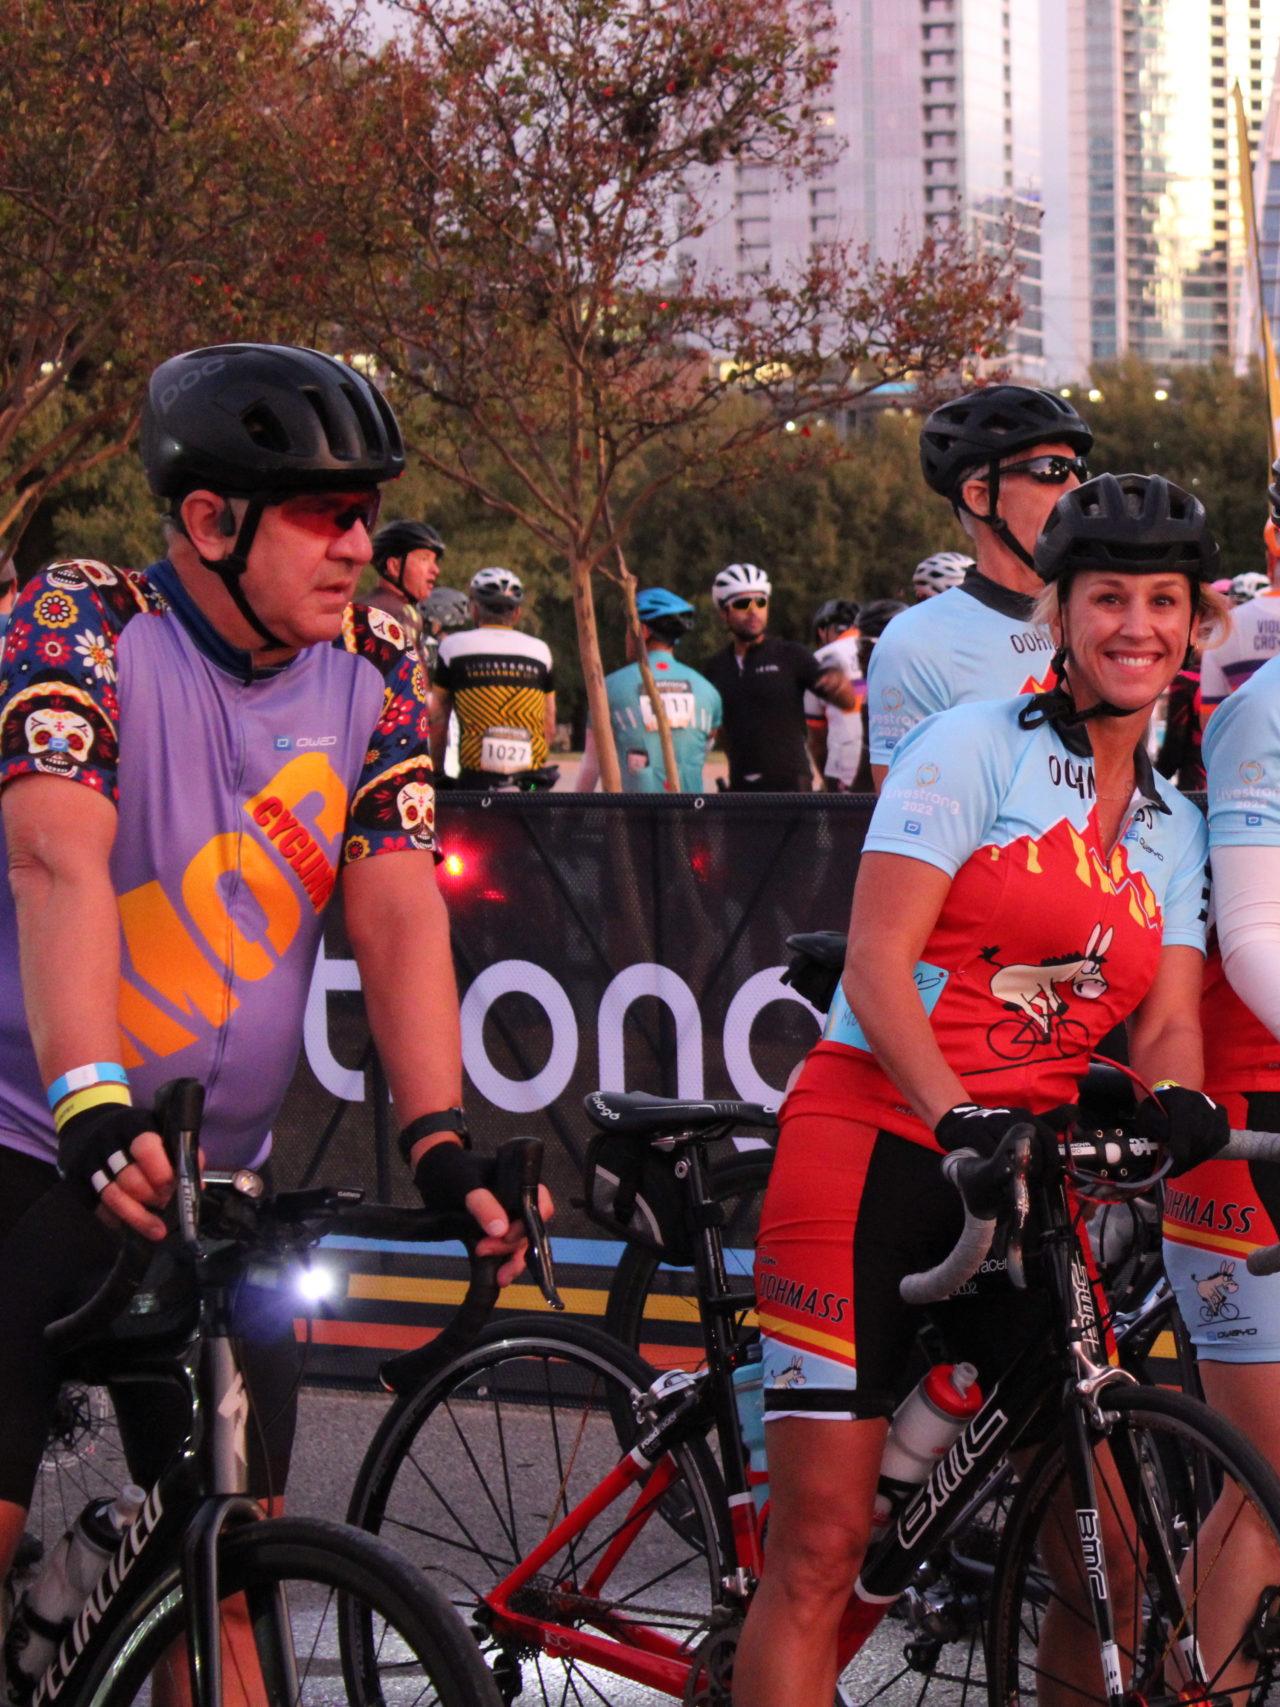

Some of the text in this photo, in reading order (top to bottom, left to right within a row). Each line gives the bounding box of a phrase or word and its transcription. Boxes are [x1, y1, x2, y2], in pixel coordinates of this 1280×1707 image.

[486, 742, 526, 761] 1027
[902, 800, 934, 817] 2022
[1075, 1508, 1108, 1601] BMC
